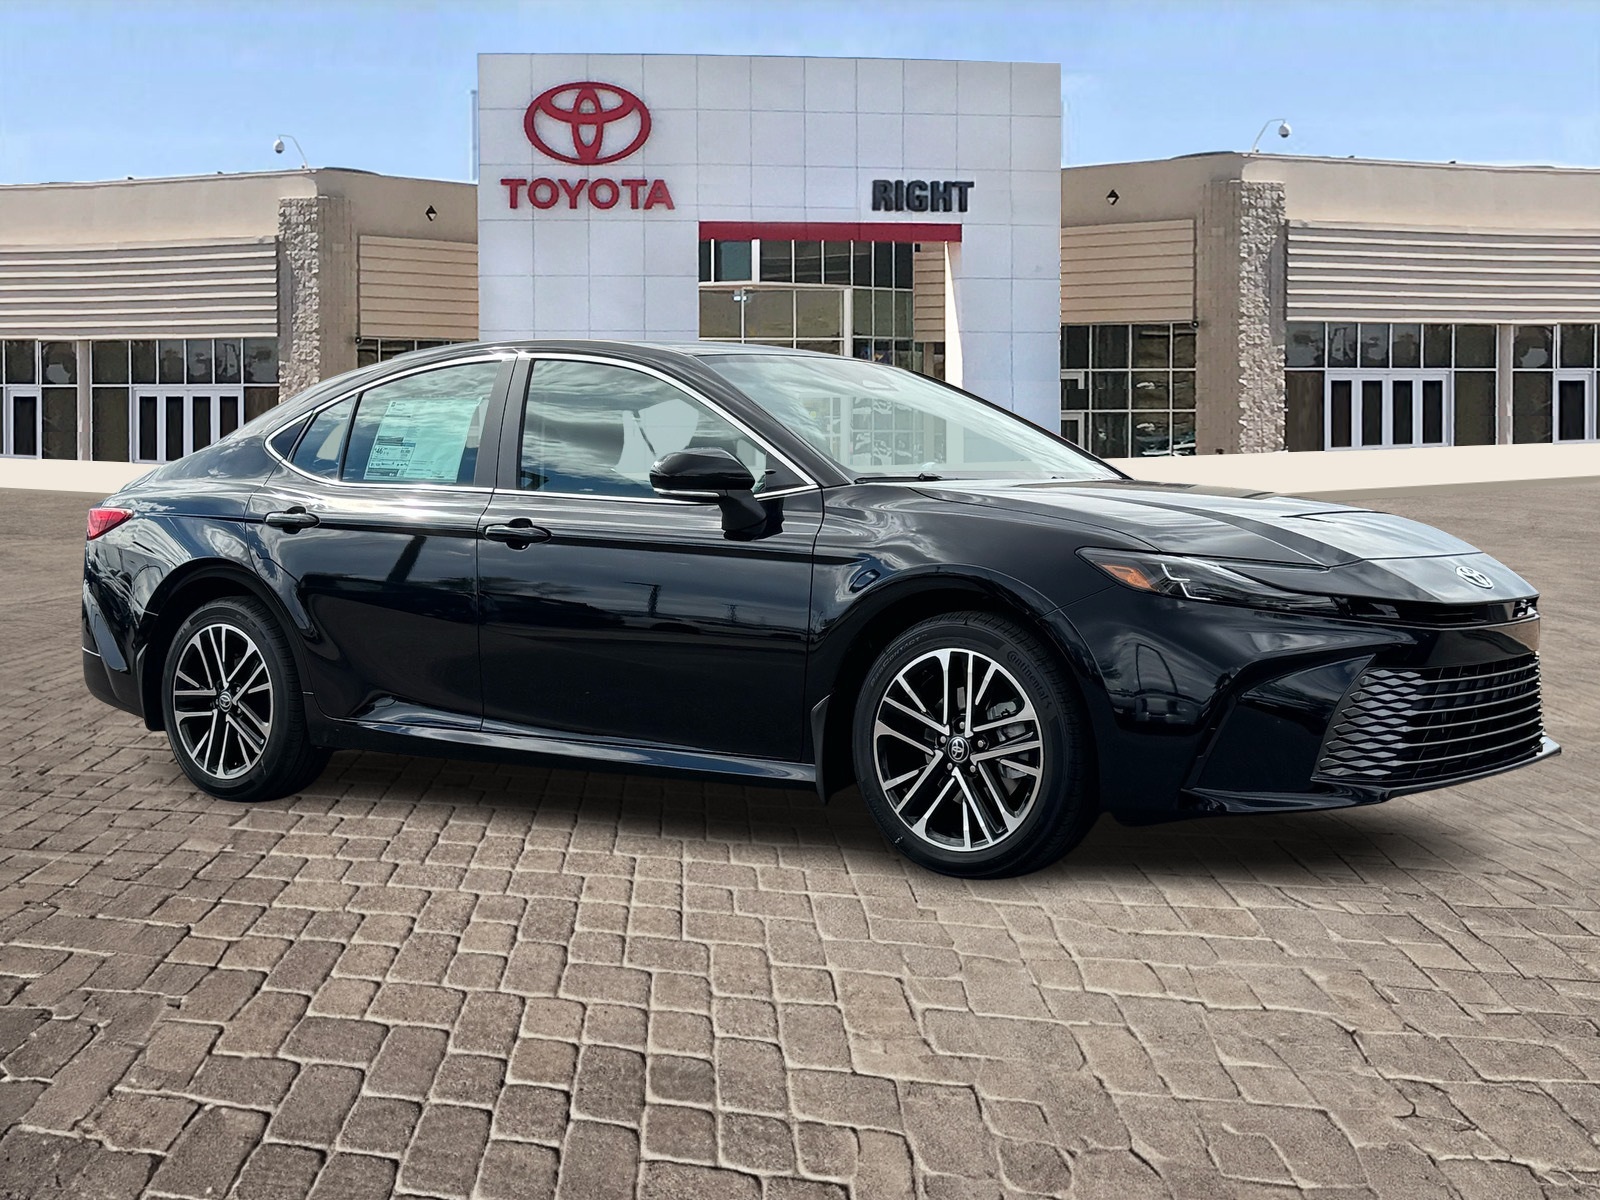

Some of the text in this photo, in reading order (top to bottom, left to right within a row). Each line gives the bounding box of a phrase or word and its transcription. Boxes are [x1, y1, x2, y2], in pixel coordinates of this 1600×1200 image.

[500, 178, 675, 210] TOYOTA
[872, 179, 975, 212] RIGHT
[1006, 650, 1049, 701] Continental
